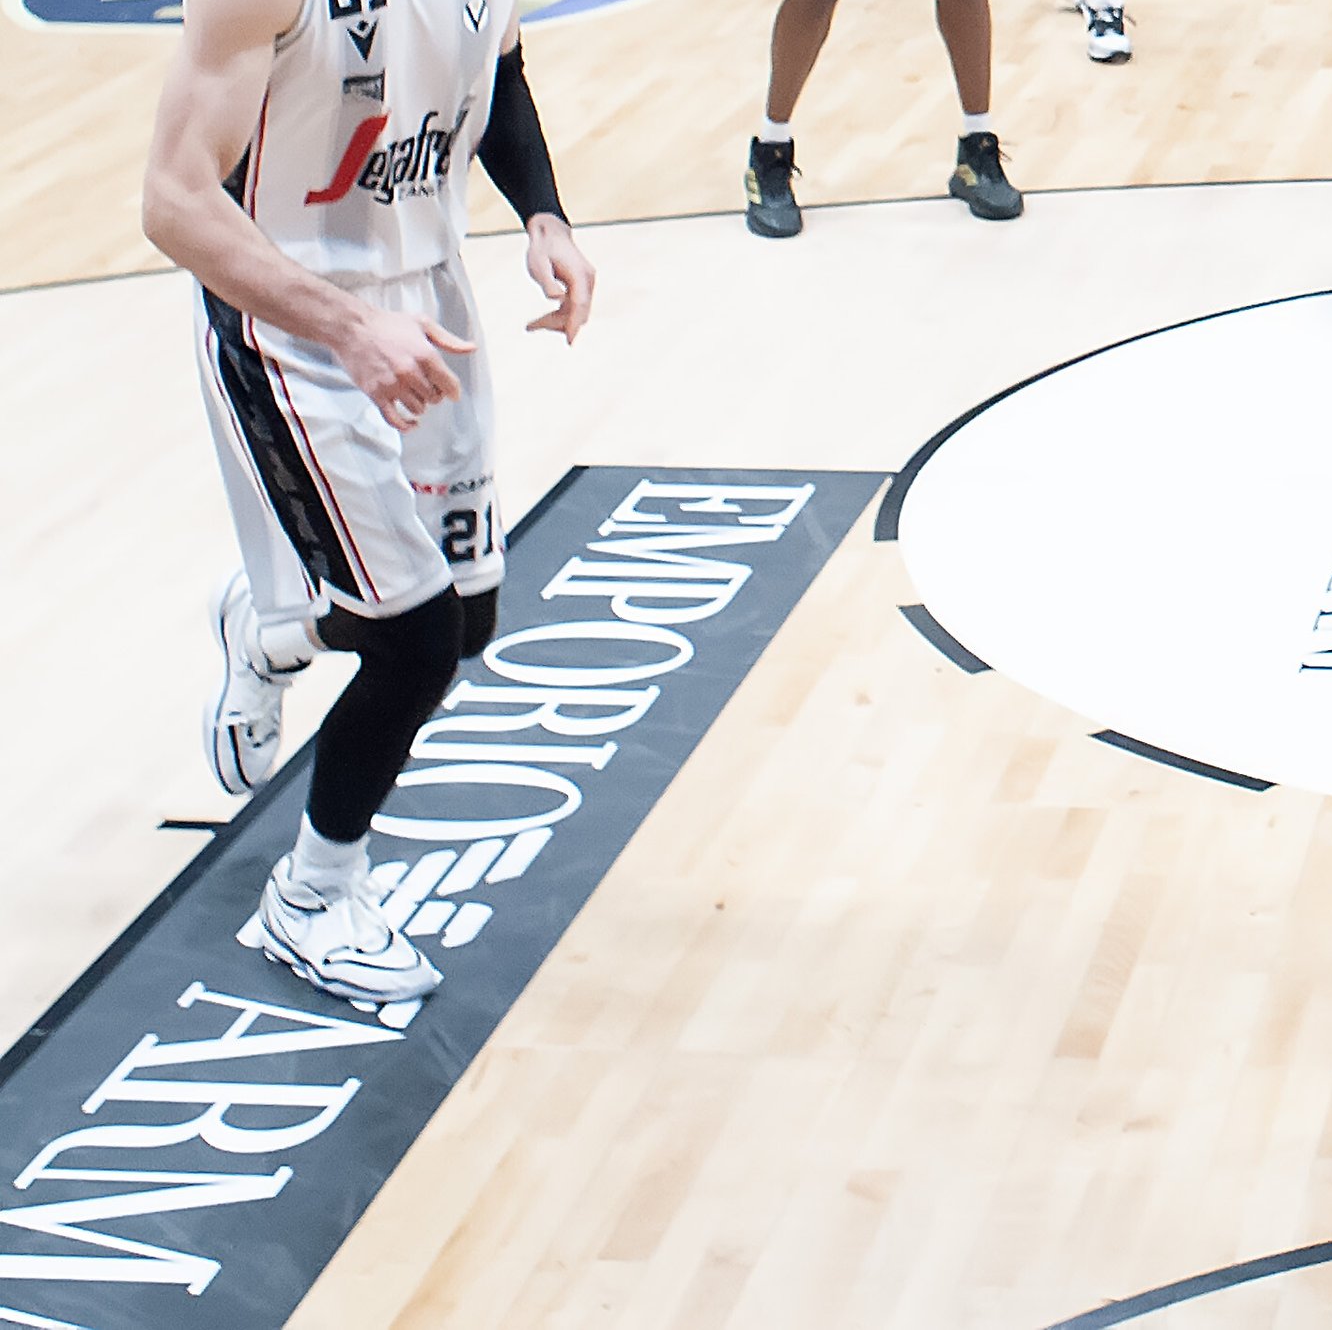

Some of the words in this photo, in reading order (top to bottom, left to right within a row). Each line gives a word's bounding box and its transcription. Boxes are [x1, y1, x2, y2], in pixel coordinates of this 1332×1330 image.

[370, 478, 817, 842] EMPORIO
[441, 500, 493, 564] 21
[0, 980, 407, 1330] ARM
